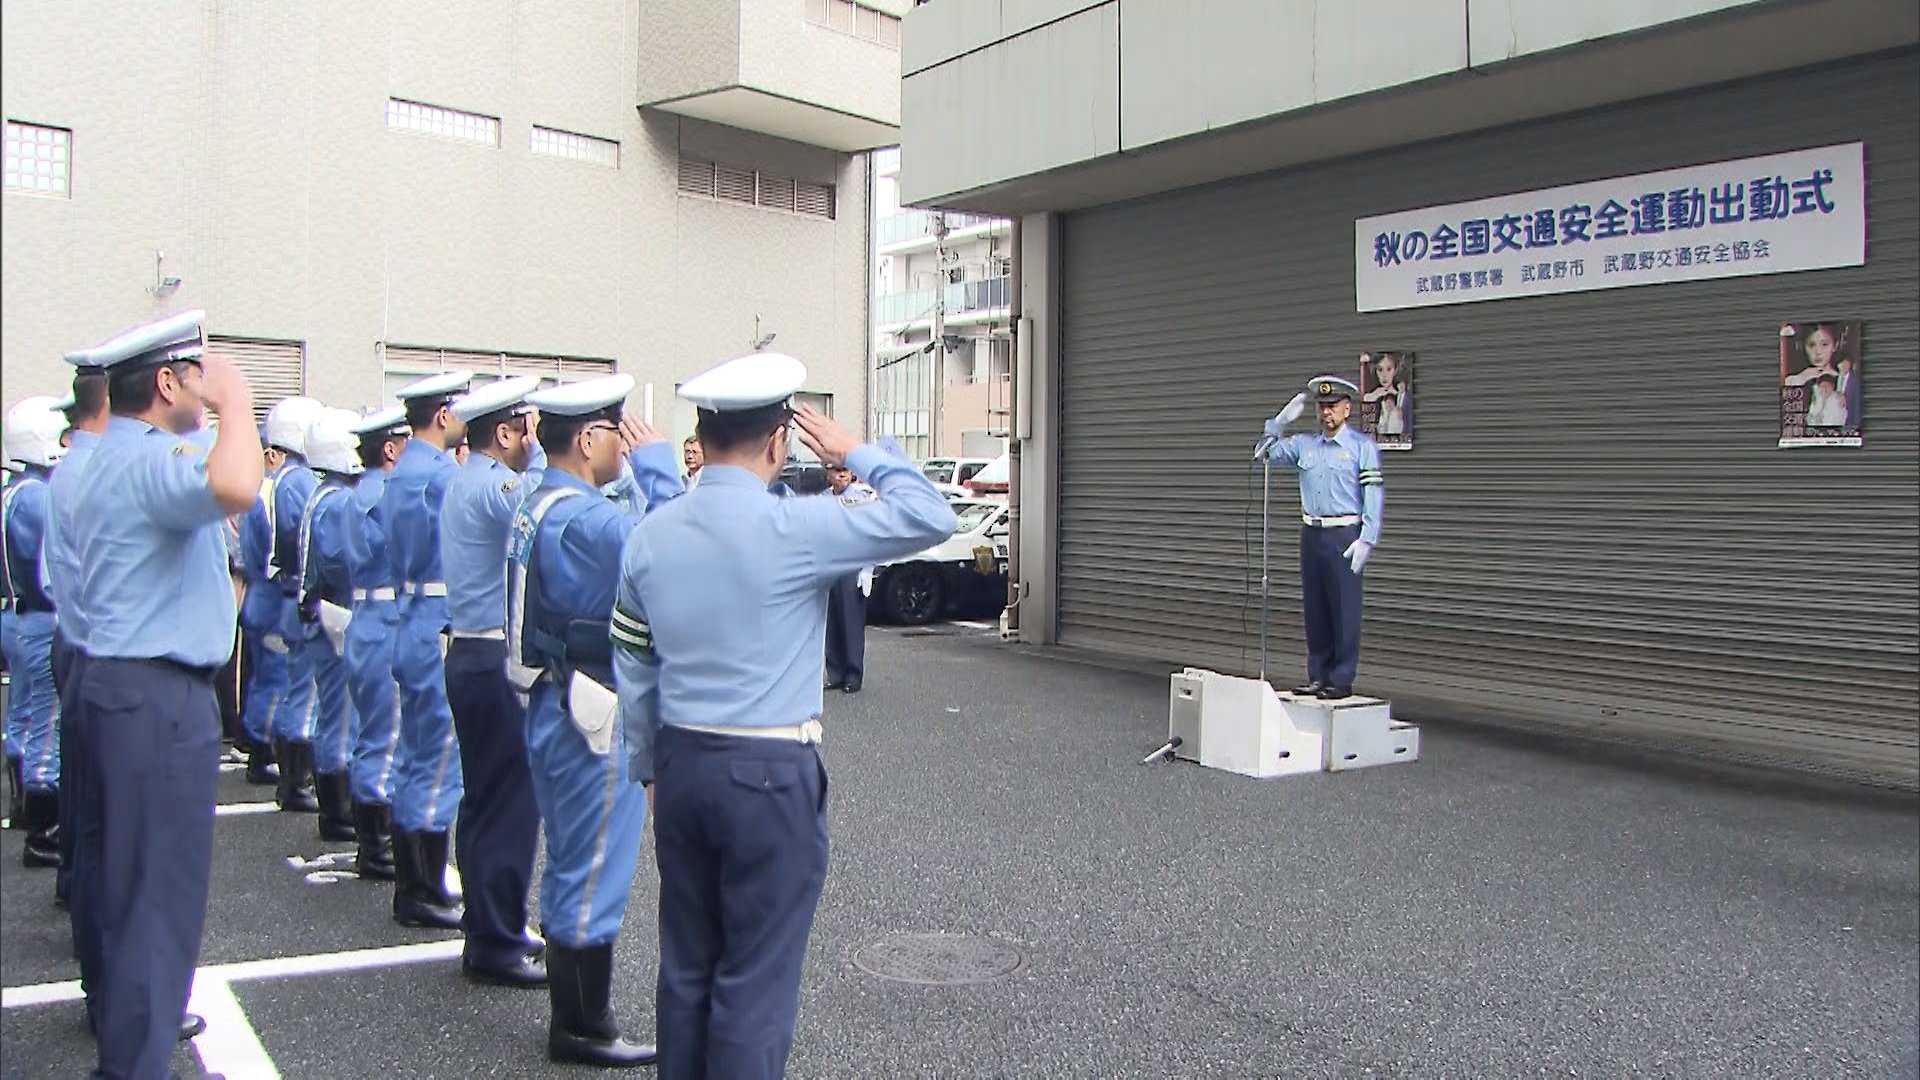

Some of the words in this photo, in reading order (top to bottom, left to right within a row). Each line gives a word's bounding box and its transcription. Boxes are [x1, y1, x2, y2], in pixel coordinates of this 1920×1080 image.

[1374, 168, 1834, 268] 秋の全国交通安全運動出動式
[1415, 268, 1504, 294] 武蔵野警察署
[1520, 258, 1585, 283] 武蔵野市
[1603, 239, 1771, 274] 武蔵野交通安全協会
